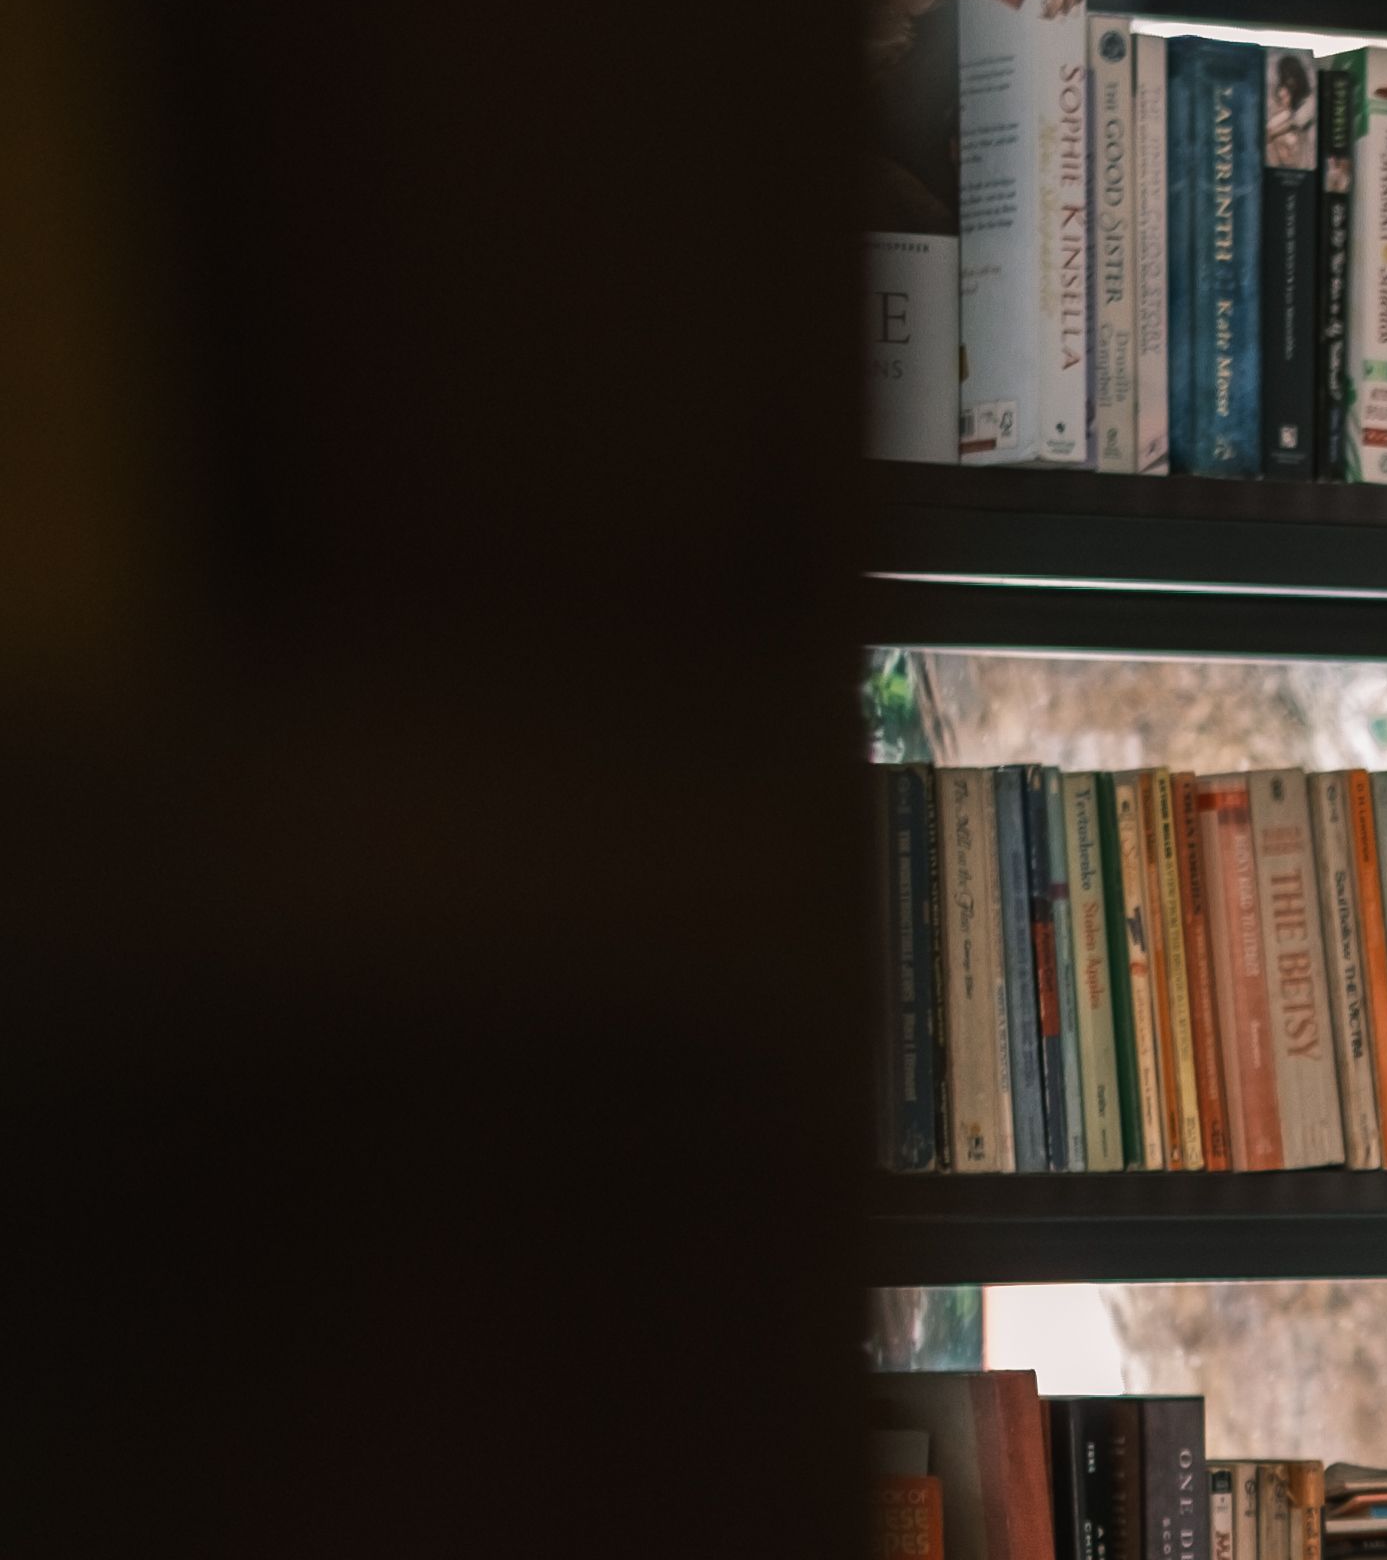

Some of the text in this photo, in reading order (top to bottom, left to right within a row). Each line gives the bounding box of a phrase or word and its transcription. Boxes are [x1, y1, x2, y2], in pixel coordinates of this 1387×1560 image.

[1102, 118, 1125, 209] GOOD
[1214, 86, 1234, 262] LABYRINTH
[1061, 204, 1084, 373] KINSELLA
[1099, 216, 1126, 306] SISTER
[1215, 301, 1233, 349] Kate
[1073, 789, 1105, 1012] Yevtushenko Stolen Apples
[1270, 869, 1307, 941] THE
[1277, 950, 1323, 1063] BETSY
[1178, 1448, 1196, 1516] ONE
